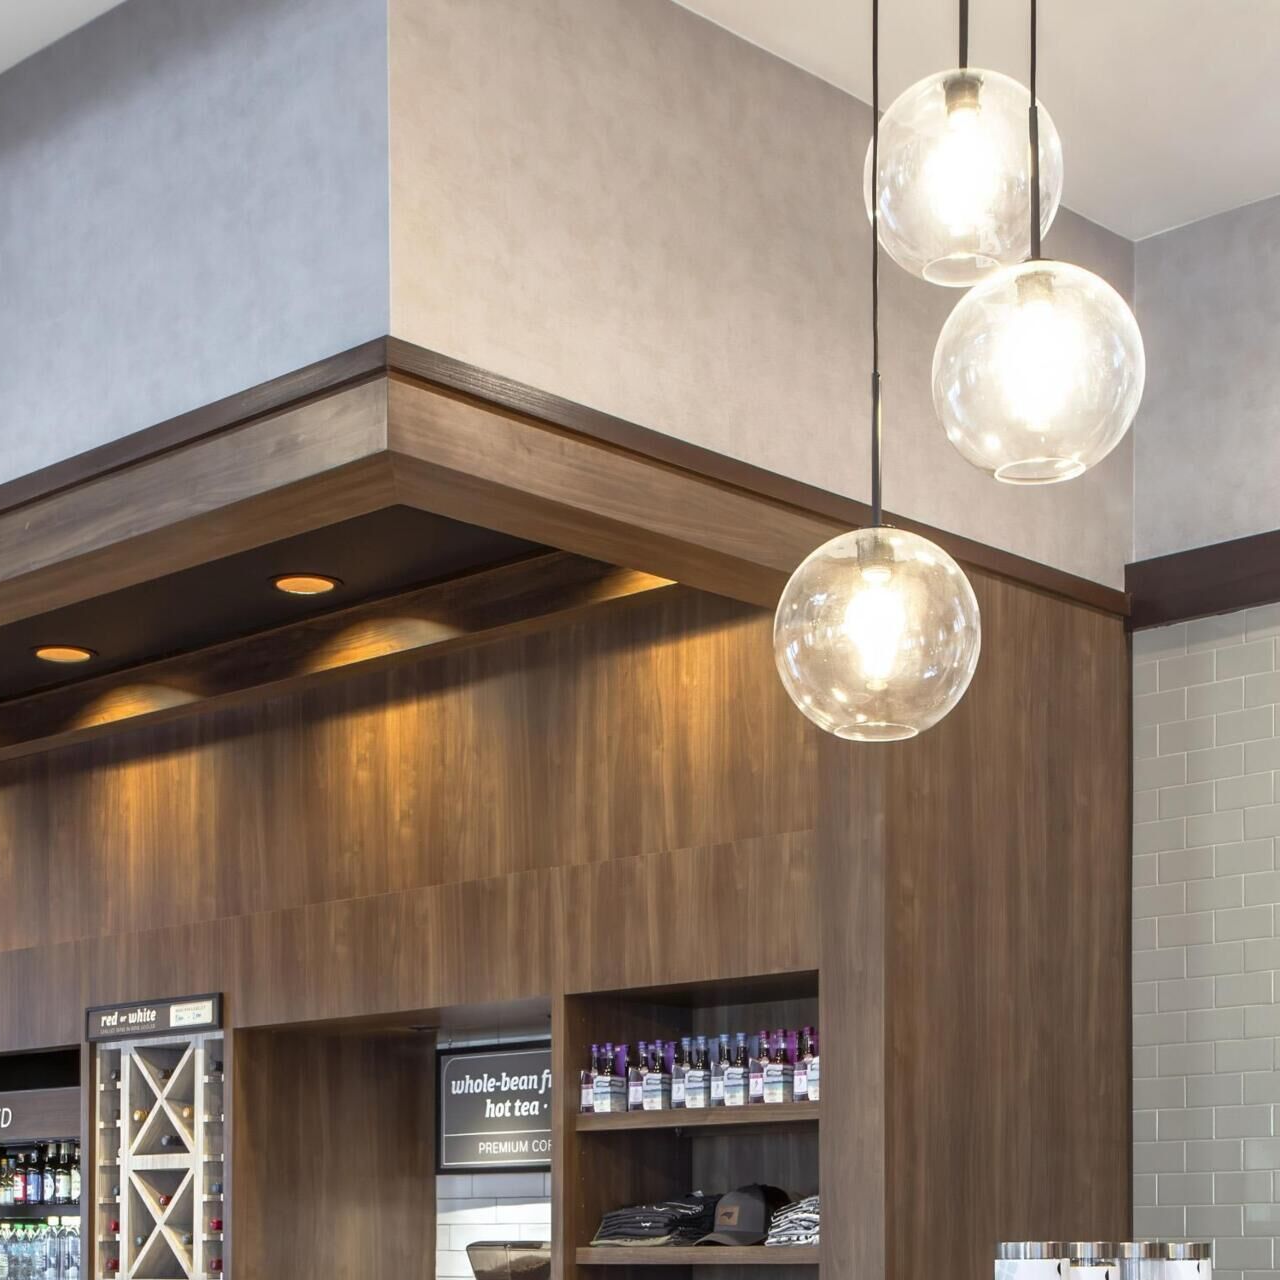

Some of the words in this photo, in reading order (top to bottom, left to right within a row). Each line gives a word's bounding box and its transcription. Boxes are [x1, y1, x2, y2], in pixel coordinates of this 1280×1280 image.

[101, 1011, 118, 1027] red
[128, 1008, 157, 1024] white
[451, 1072, 538, 1095] whole-bean
[485, 1099, 511, 1118] hot
[514, 1099, 540, 1116] tea
[478, 1140, 529, 1154] PREMIUM
